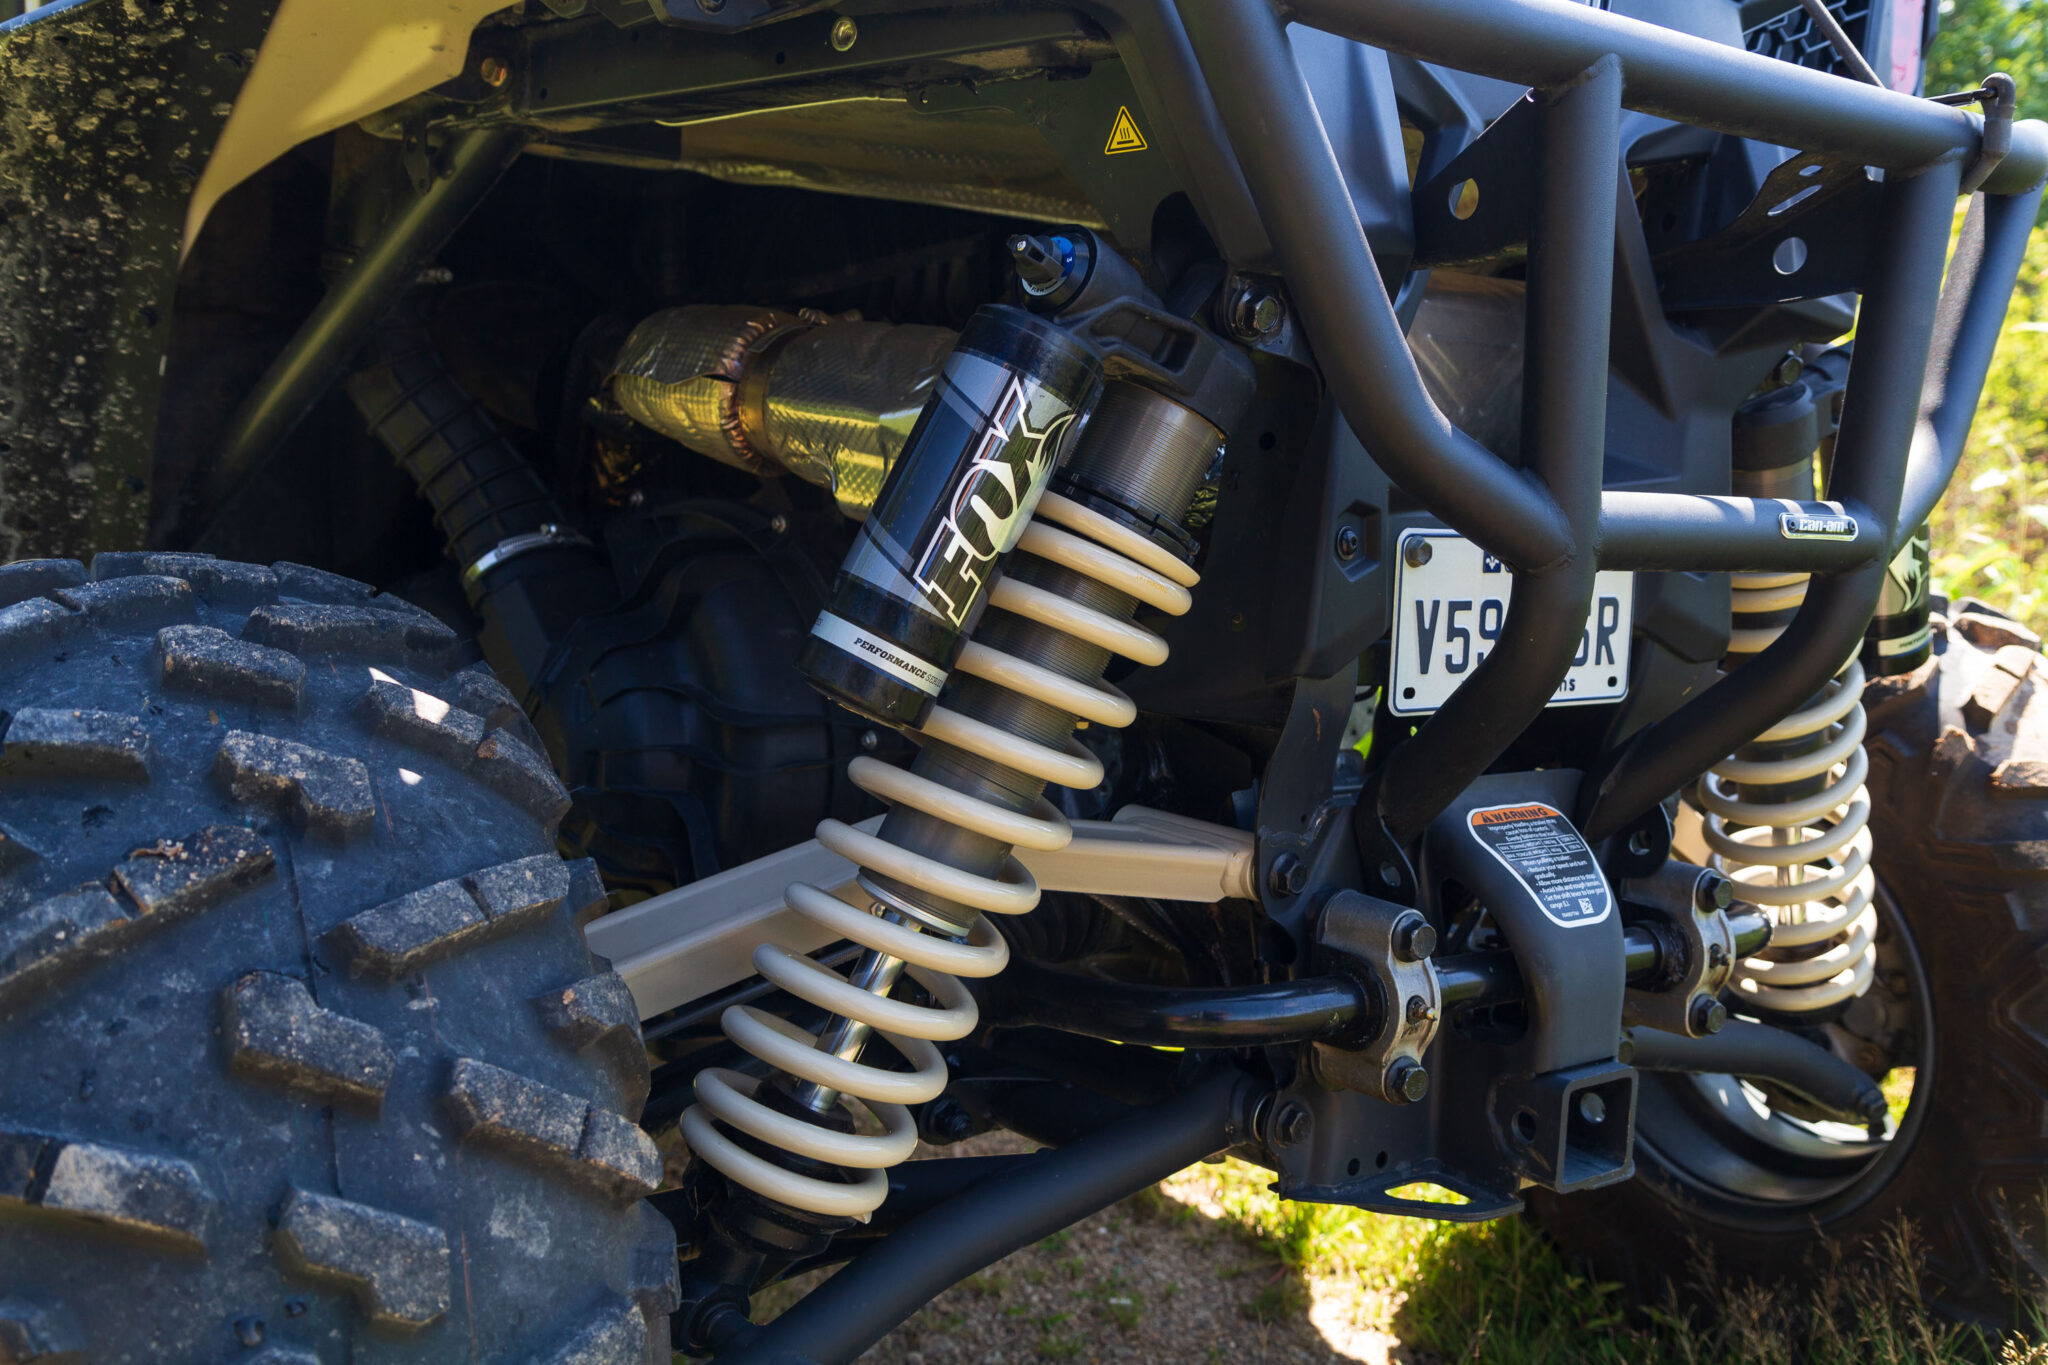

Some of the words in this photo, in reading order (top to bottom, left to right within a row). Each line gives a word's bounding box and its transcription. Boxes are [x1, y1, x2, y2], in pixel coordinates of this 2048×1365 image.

[913, 376, 1076, 627] FOX
[853, 637, 928, 679] PERFORMANCE
[1415, 596, 1619, 675] V59R
[1490, 807, 1548, 822] WARNING
